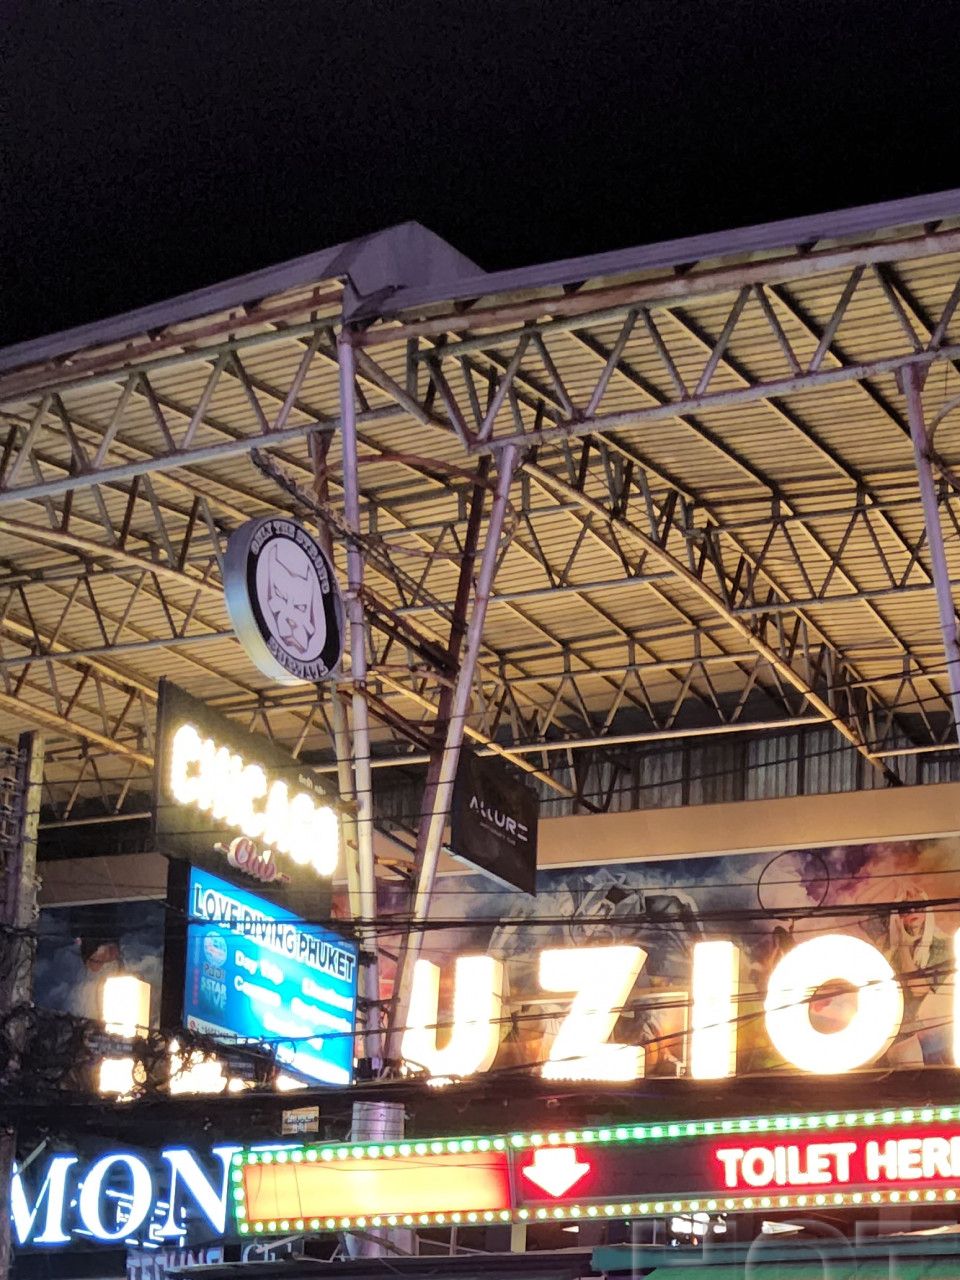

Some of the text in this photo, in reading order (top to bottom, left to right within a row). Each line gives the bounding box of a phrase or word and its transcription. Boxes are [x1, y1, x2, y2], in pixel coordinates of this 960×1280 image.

[194, 882, 239, 932] LOVE
[243, 905, 296, 954] DIVING
[298, 932, 356, 982] PHUKET
[716, 1141, 857, 1189] TOILET
